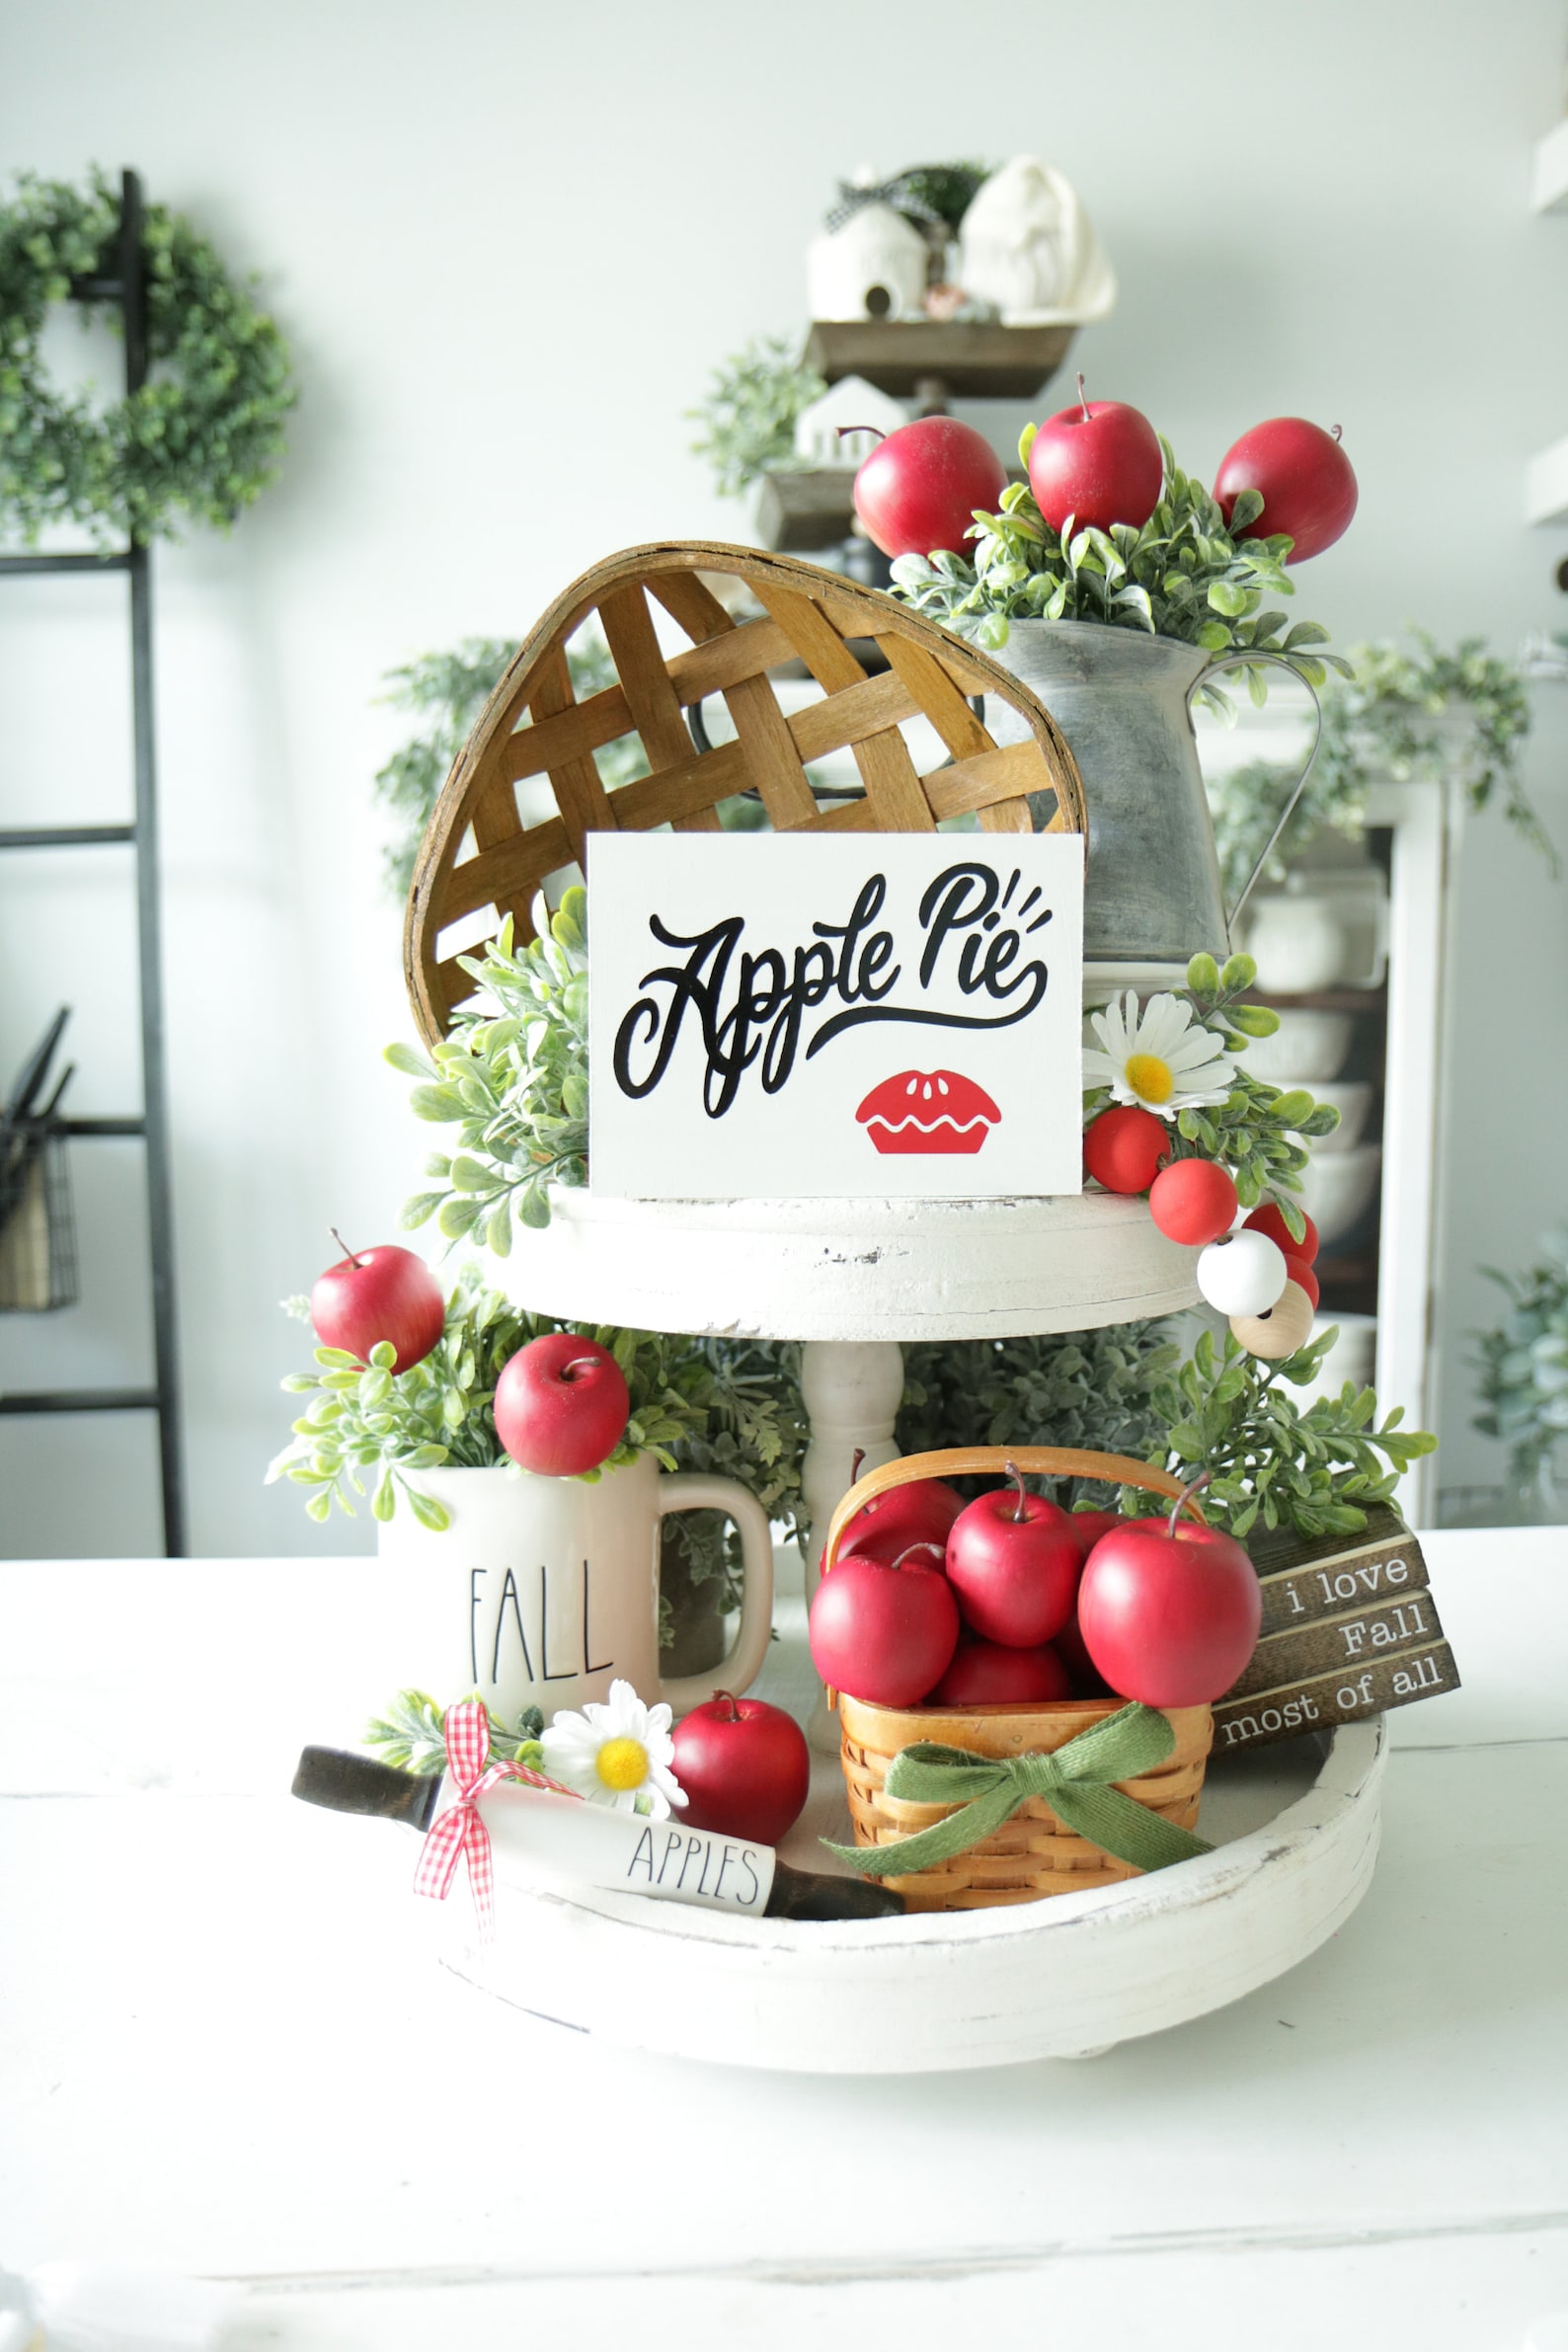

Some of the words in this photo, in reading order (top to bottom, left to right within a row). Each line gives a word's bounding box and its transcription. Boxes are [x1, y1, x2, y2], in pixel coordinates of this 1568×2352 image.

[613, 873, 902, 1119] Apple
[918, 862, 1050, 1029] Pie
[471, 1559, 614, 1684] FALL
[1287, 1582, 1304, 1613] i
[1316, 1557, 1408, 1604] love
[1338, 1604, 1428, 1656] Fall
[1220, 1694, 1319, 1746] most
[1336, 1675, 1374, 1709] of
[1392, 1656, 1443, 1694] all
[627, 1826, 759, 1906] APPLES
